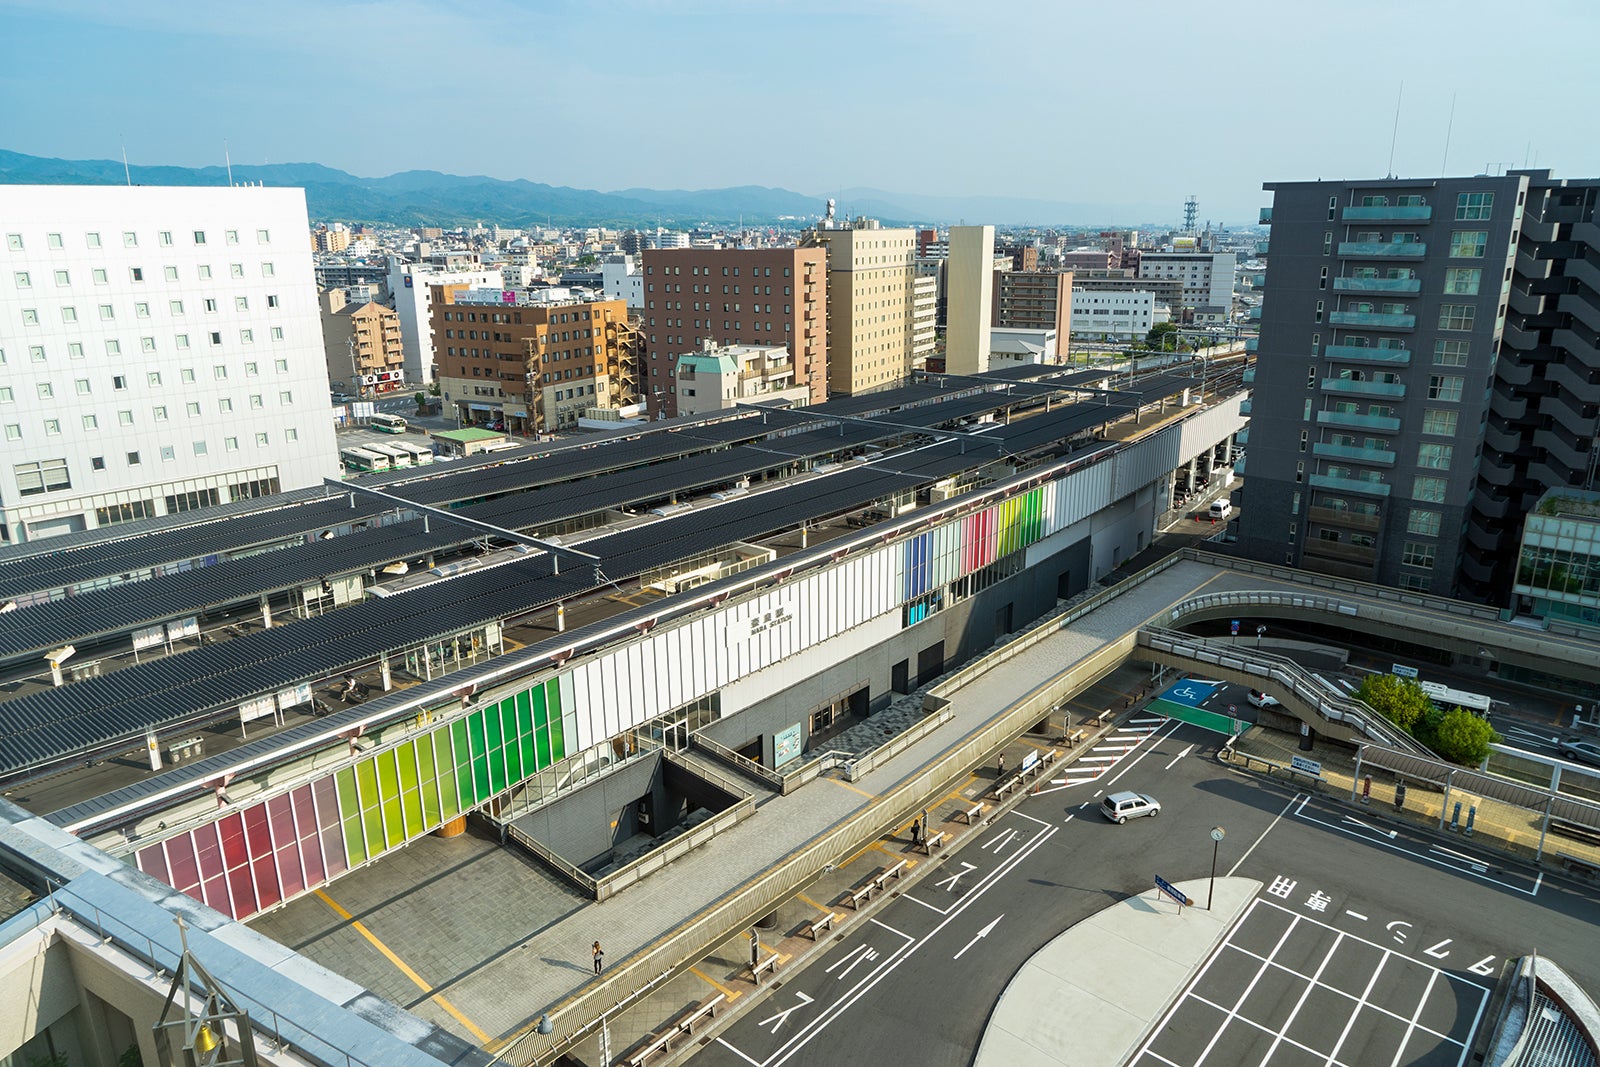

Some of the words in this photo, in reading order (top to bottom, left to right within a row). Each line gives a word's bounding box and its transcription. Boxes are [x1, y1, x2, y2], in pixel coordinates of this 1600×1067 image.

[751, 625, 767, 635] NARA
[770, 614, 792, 628] STATION
[1266, 875, 1497, 976] タクシー専用
[758, 943, 880, 1034] バス
